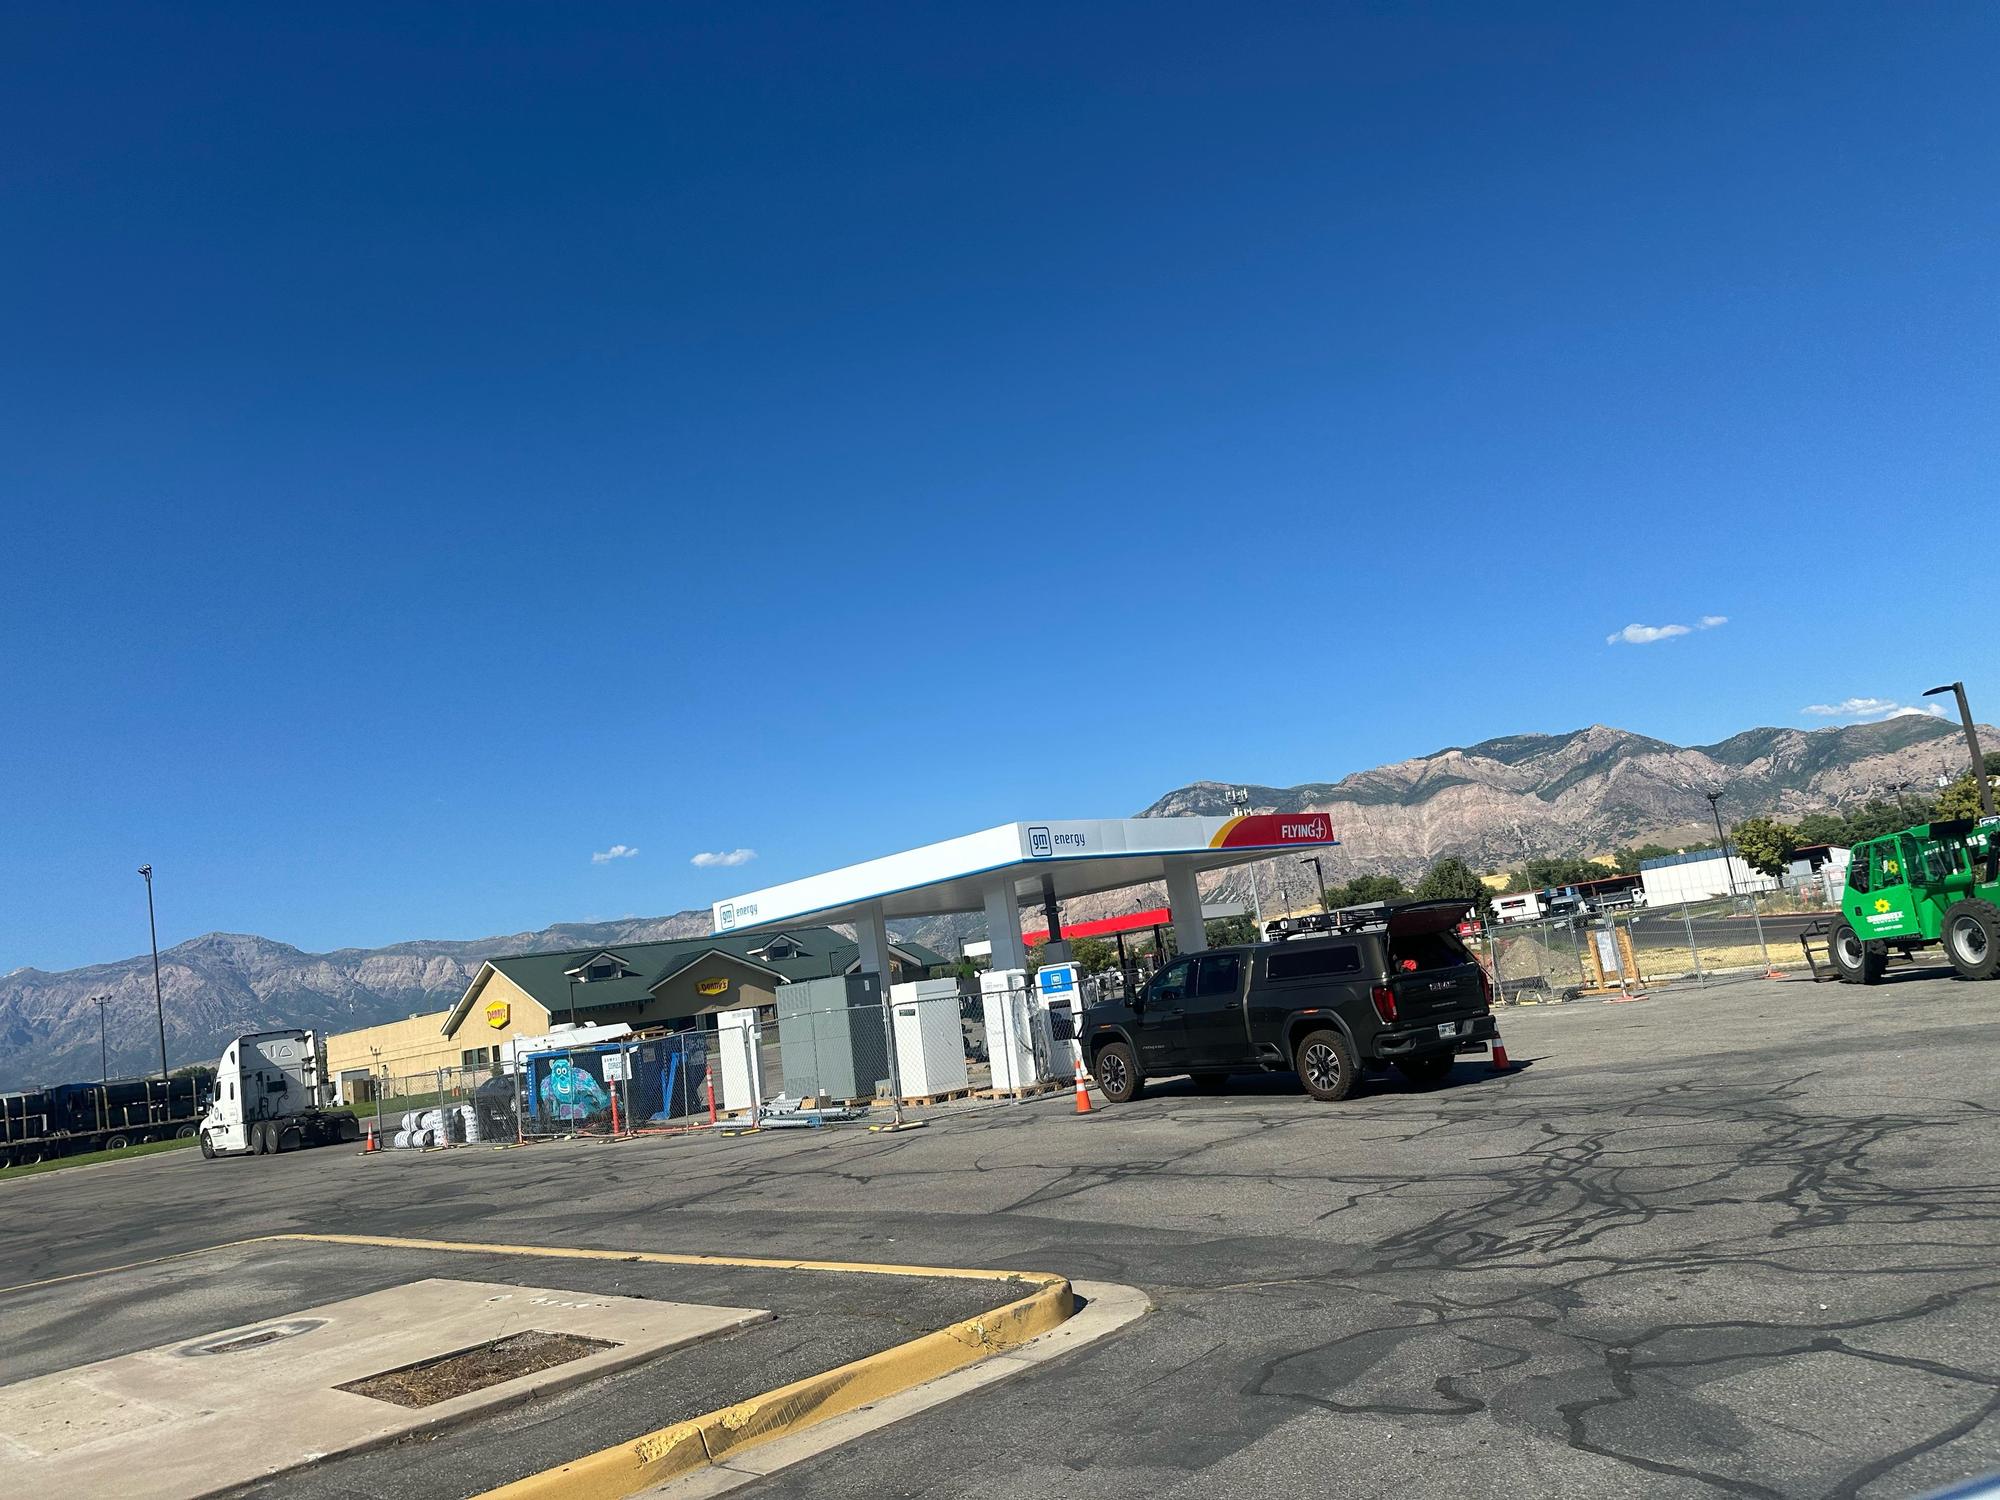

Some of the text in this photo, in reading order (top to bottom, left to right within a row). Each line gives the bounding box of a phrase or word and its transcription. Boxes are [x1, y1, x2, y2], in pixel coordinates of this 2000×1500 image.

[1281, 824, 1315, 838] FLYING
[1033, 833, 1086, 849] gm energy
[722, 904, 758, 924] gm energy
